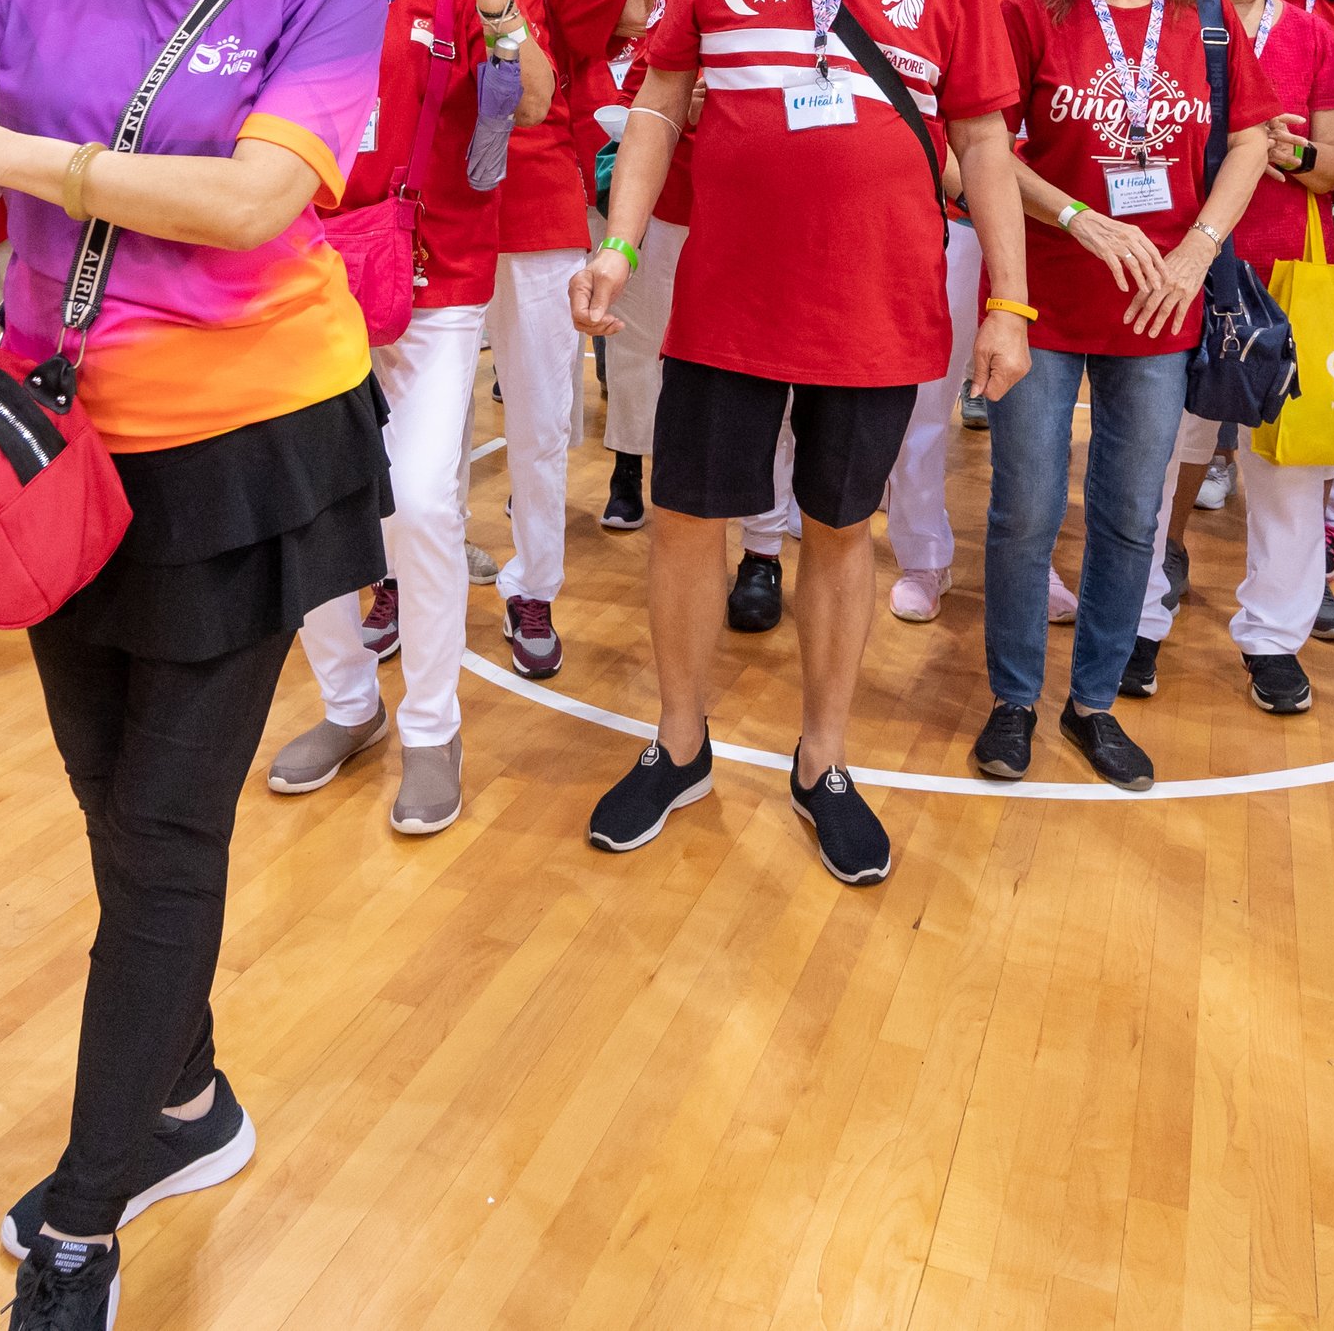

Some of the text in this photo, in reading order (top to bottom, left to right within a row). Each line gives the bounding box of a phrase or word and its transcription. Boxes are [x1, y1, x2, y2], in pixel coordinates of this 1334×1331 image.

[227, 49, 258, 62] Team
[1050, 84, 1212, 134] Singpore
[1127, 175, 1156, 187] Health
